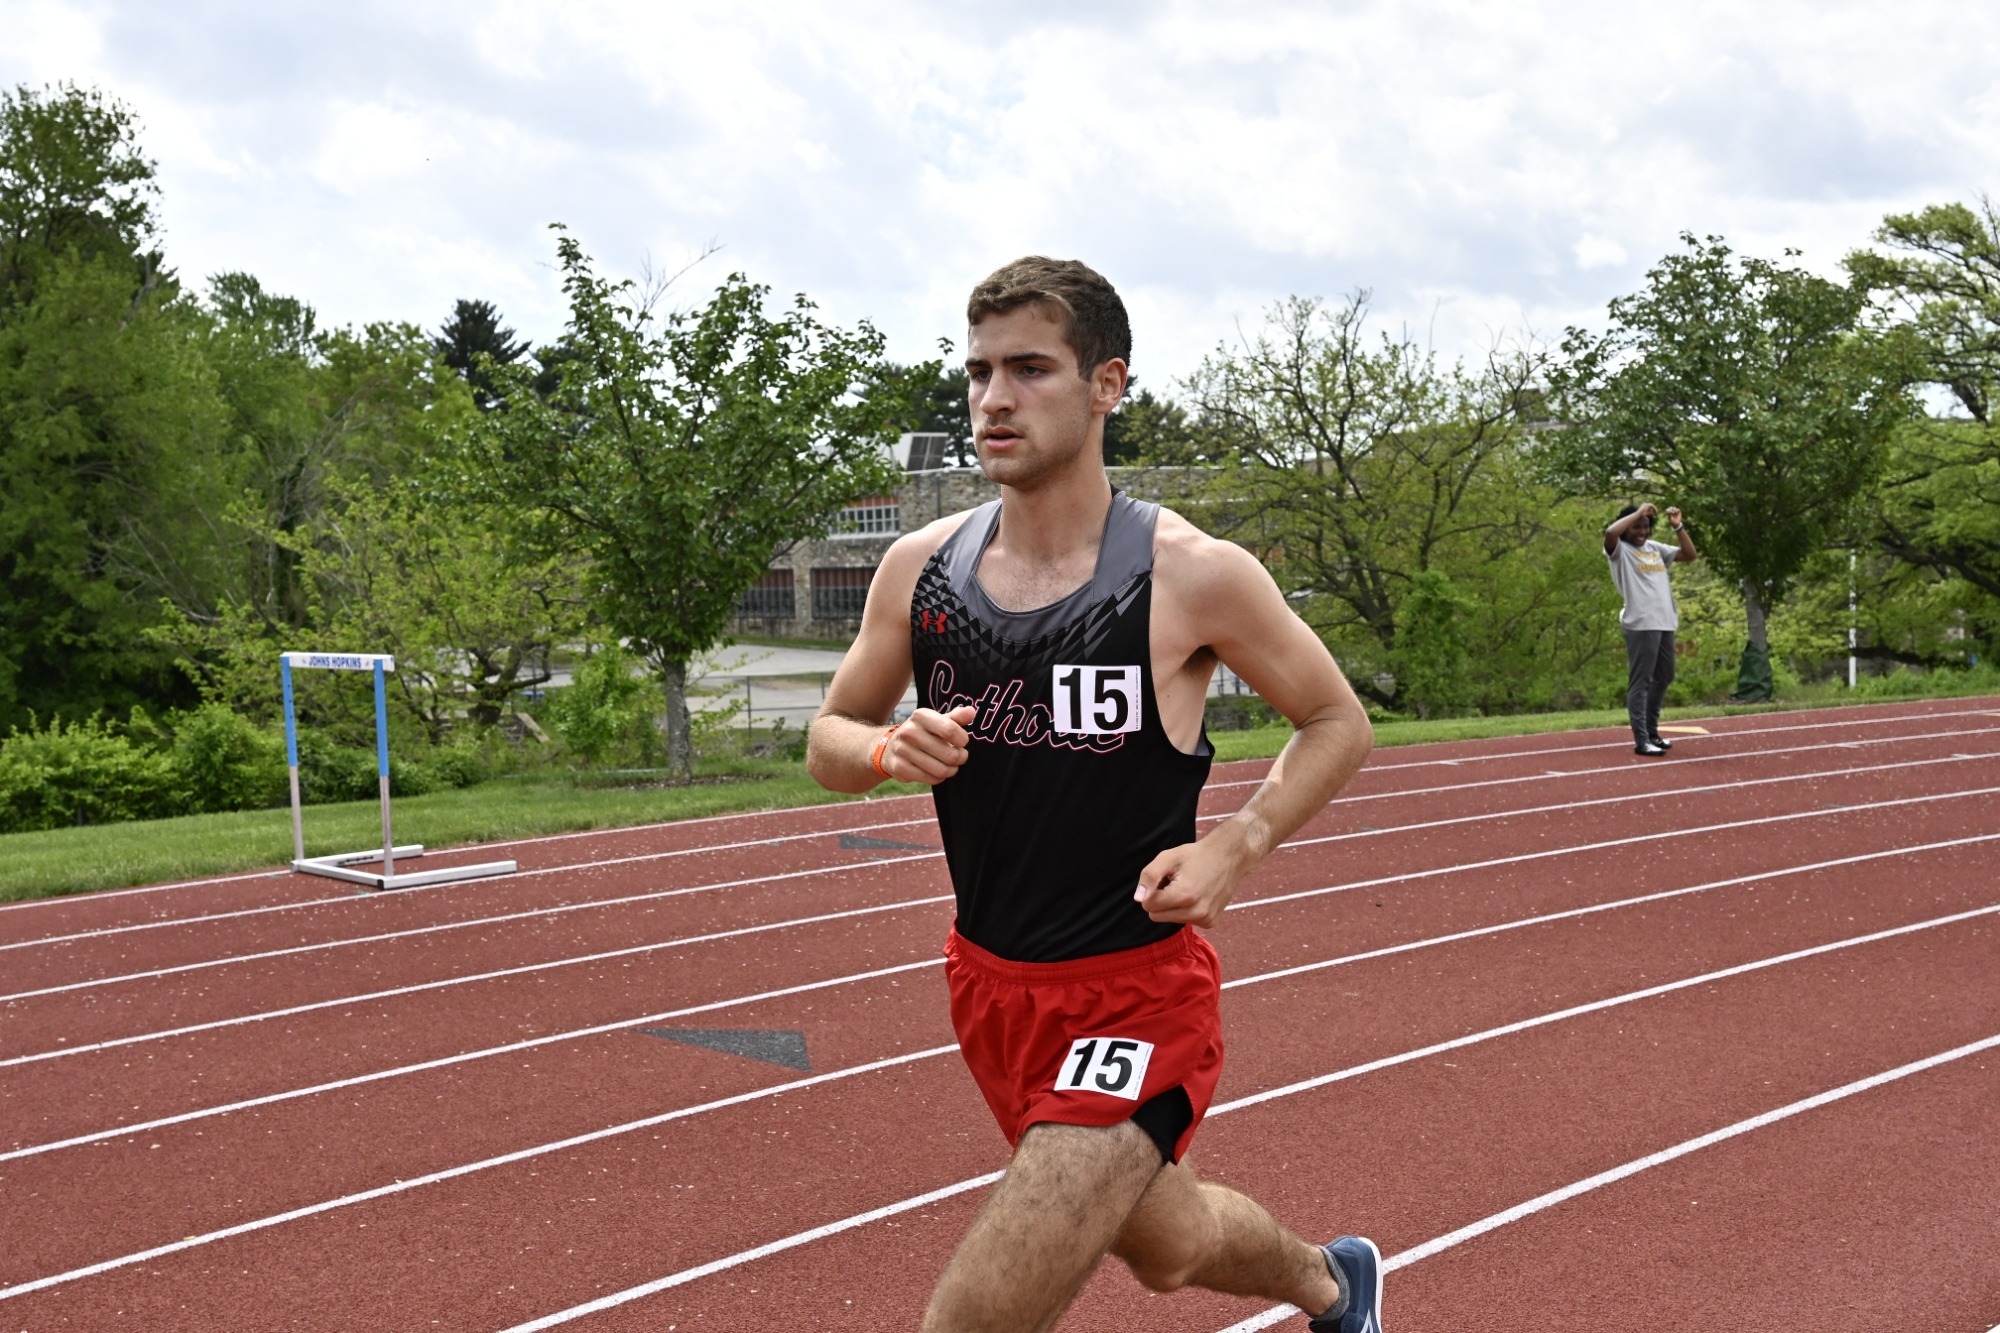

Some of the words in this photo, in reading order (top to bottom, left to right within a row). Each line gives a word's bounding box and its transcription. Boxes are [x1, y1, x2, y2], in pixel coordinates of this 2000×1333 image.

[309, 656, 330, 667] JOHNS
[332, 657, 361, 668] HOPKINS
[1059, 668, 1128, 731] 15
[1070, 1039, 1139, 1092] 15
